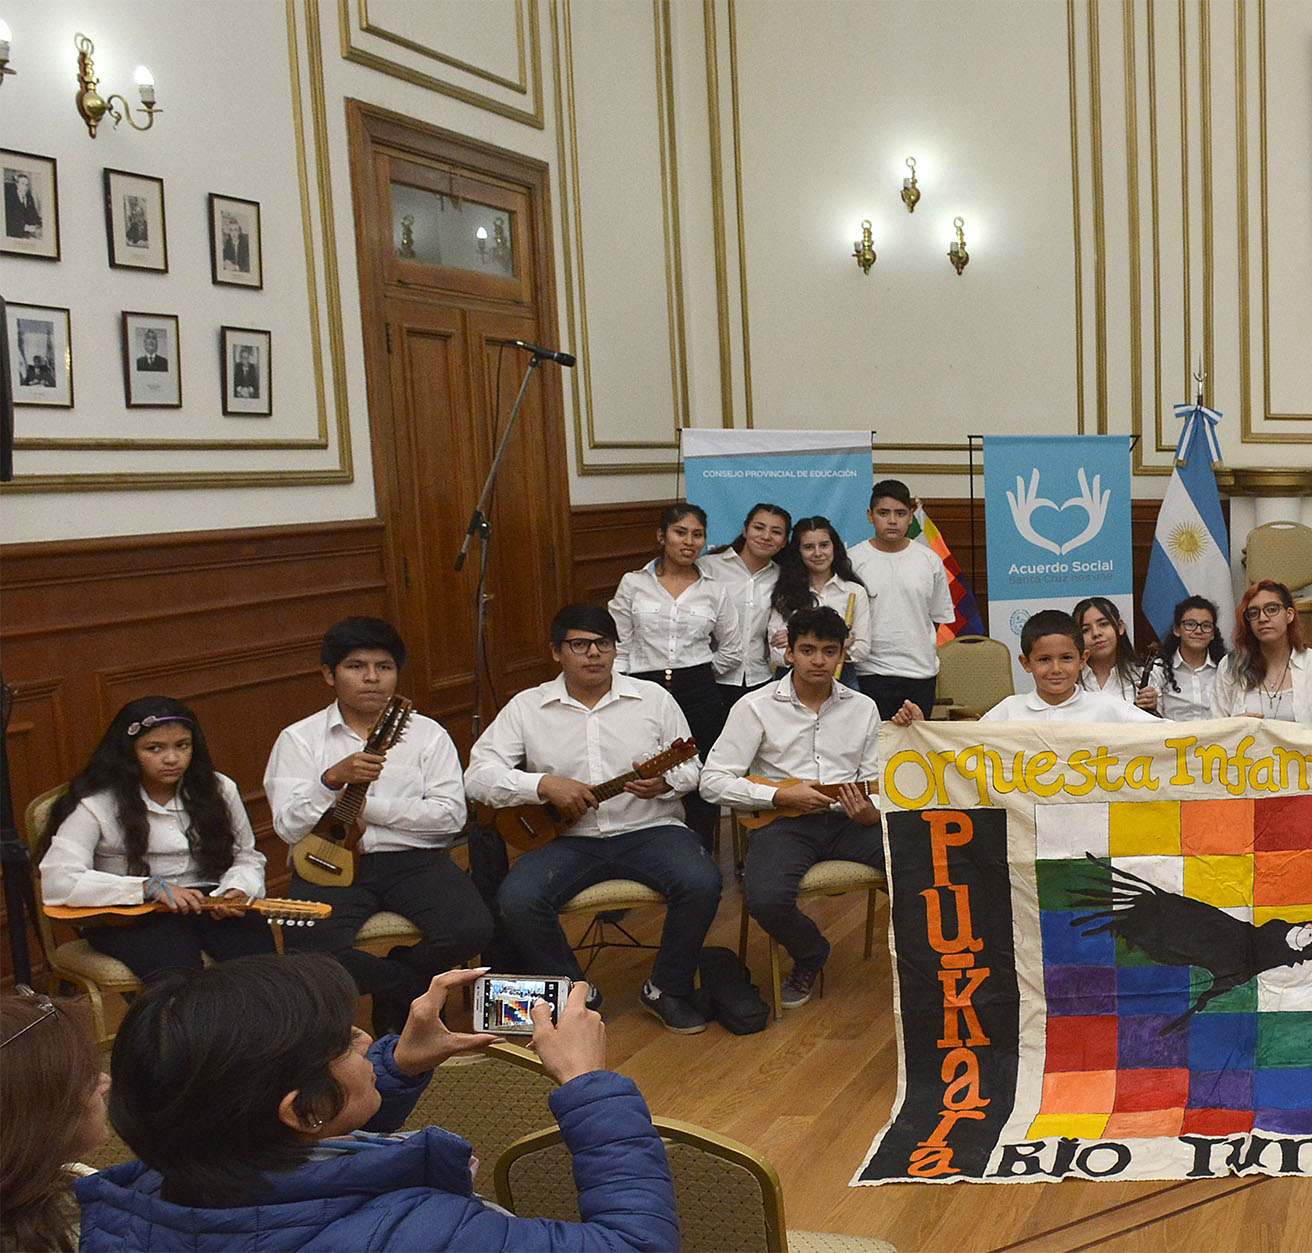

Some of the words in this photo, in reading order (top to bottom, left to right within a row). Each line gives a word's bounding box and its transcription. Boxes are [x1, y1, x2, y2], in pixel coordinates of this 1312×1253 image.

[702, 470, 744, 479] CONSEJO
[745, 470, 796, 478] PROVINCIAL
[797, 470, 808, 478] DE
[810, 468, 858, 478] EDUCACIÓN
[1009, 562, 1069, 574] Acuerdo
[1072, 559, 1114, 573] Social
[884, 743, 1160, 810] Orquesta
